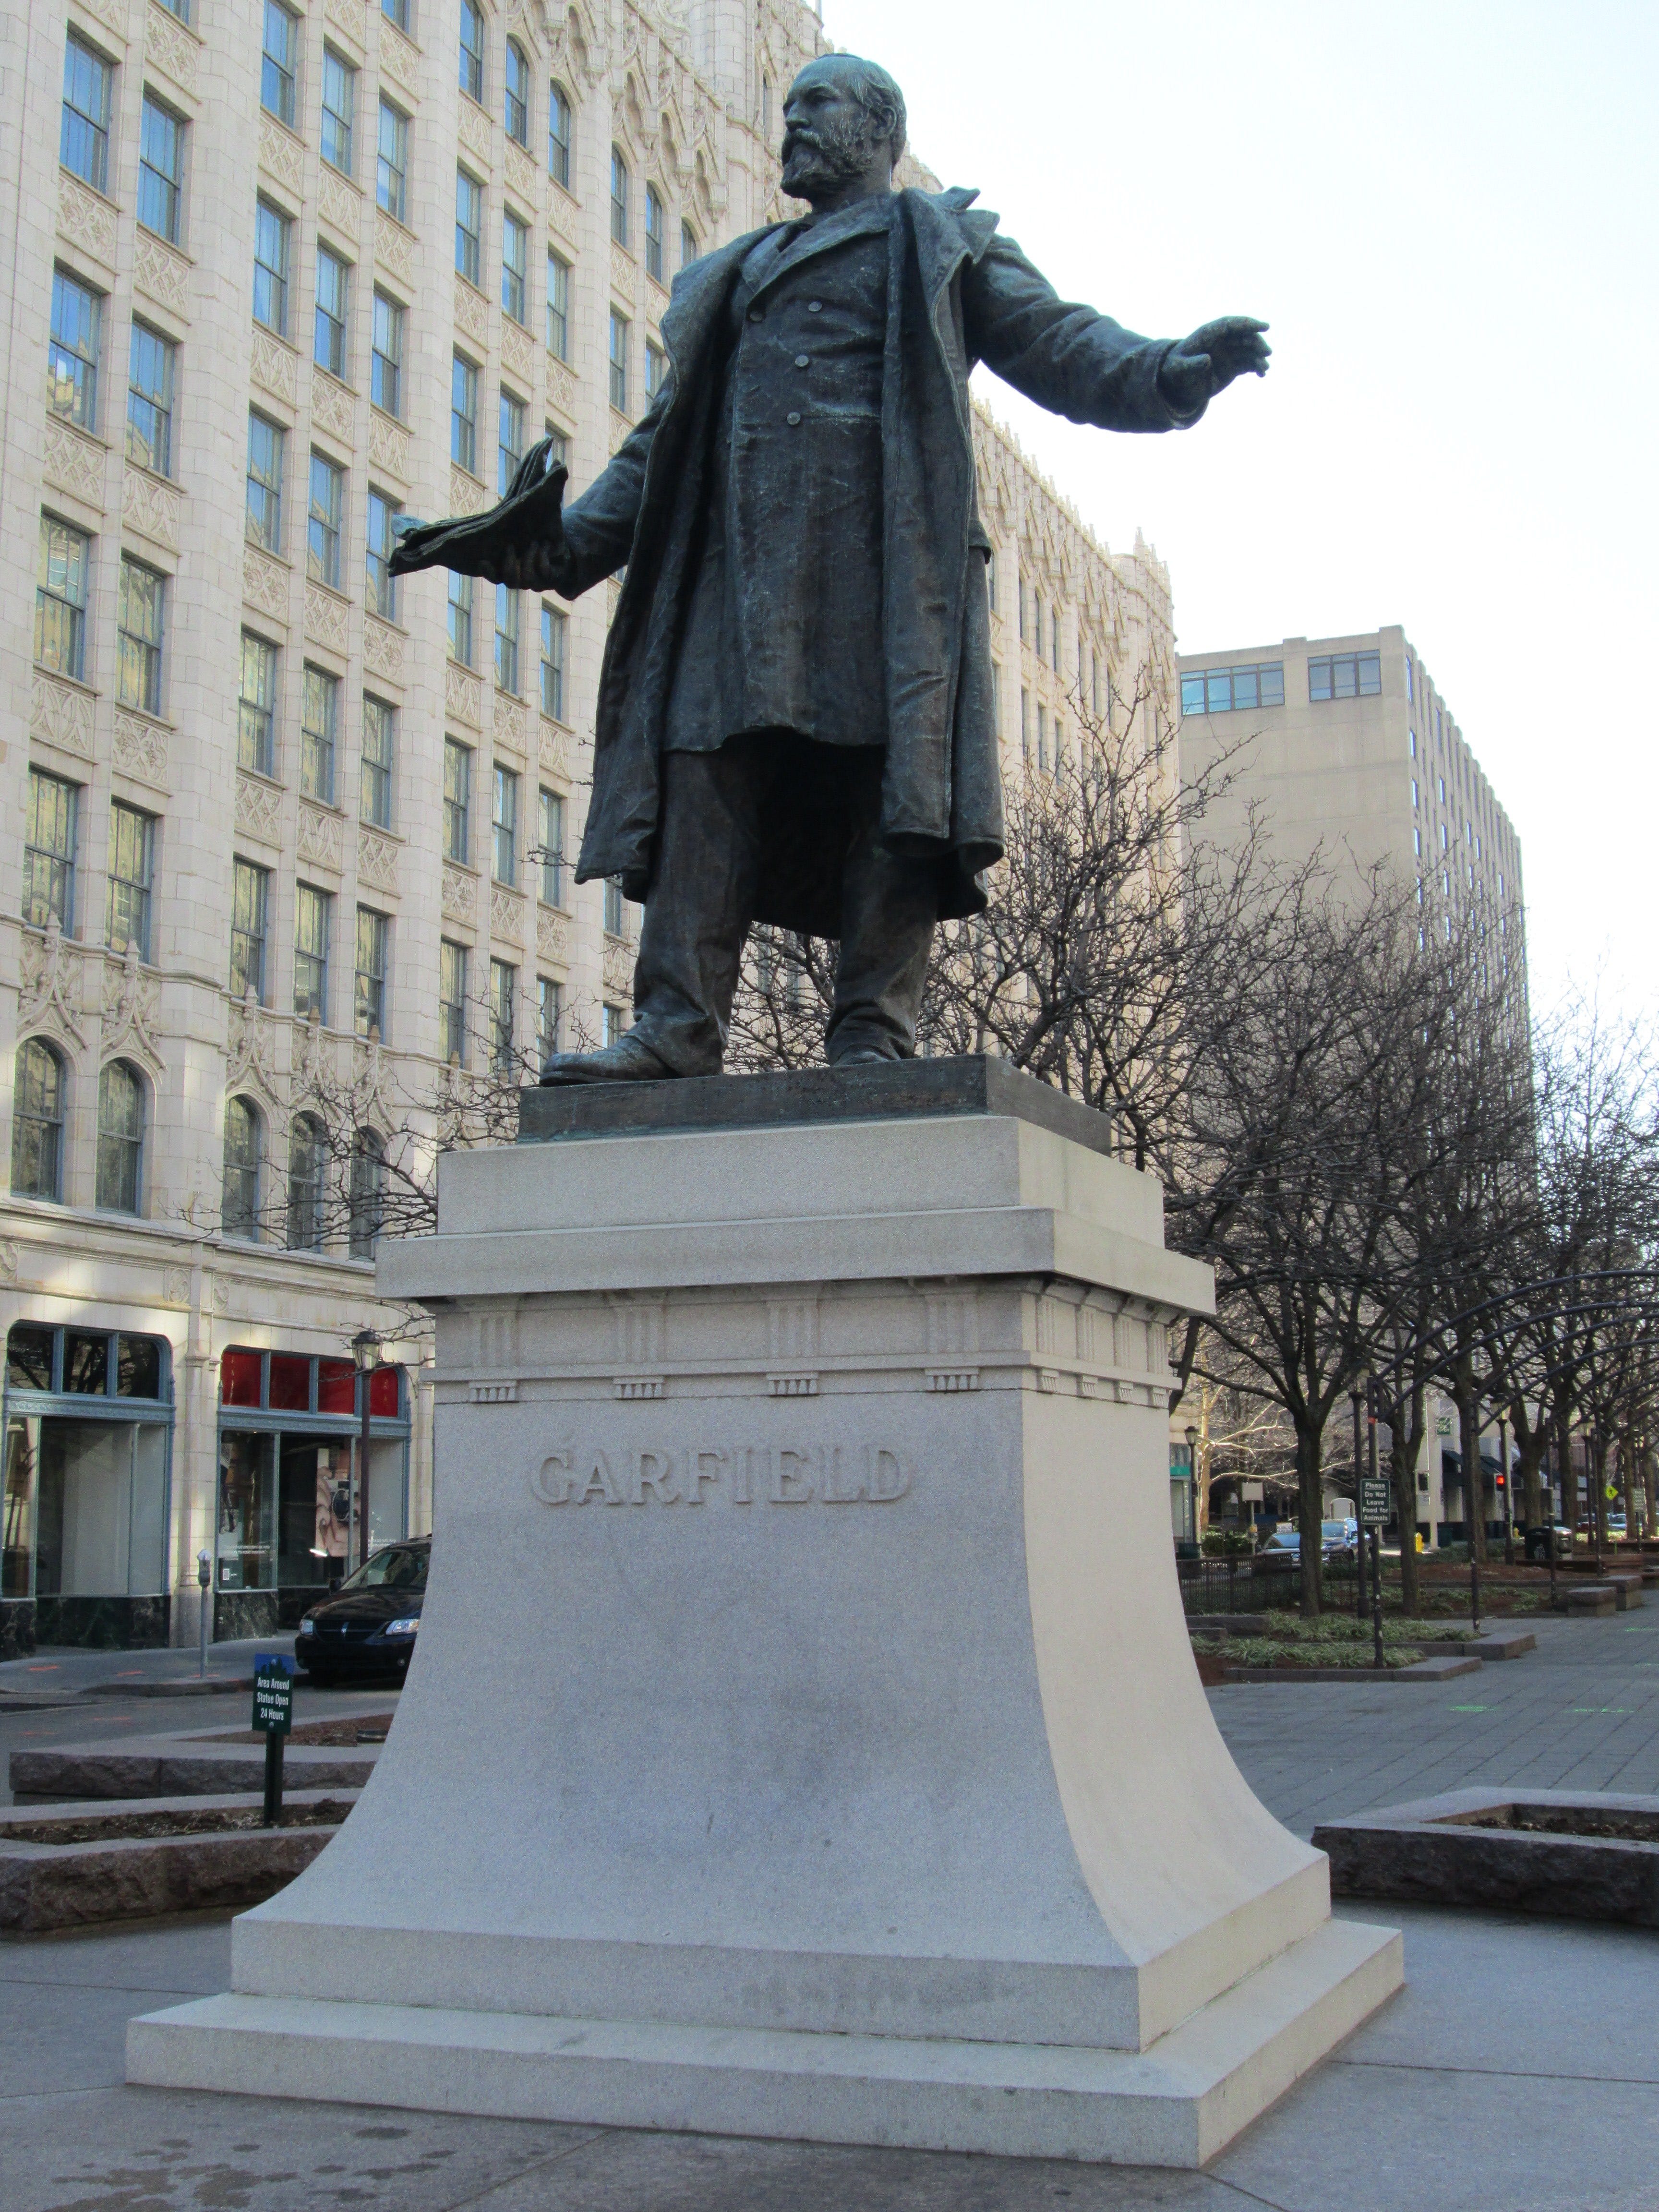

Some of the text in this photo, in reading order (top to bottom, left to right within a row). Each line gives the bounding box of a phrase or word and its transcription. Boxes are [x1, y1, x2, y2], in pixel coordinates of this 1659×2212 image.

[530, 1447, 912, 1505] GARFIELD
[257, 1677, 289, 1690] Area Around
[257, 1692, 289, 1707] Statue Open
[260, 1707, 284, 1720] 24 Hours
